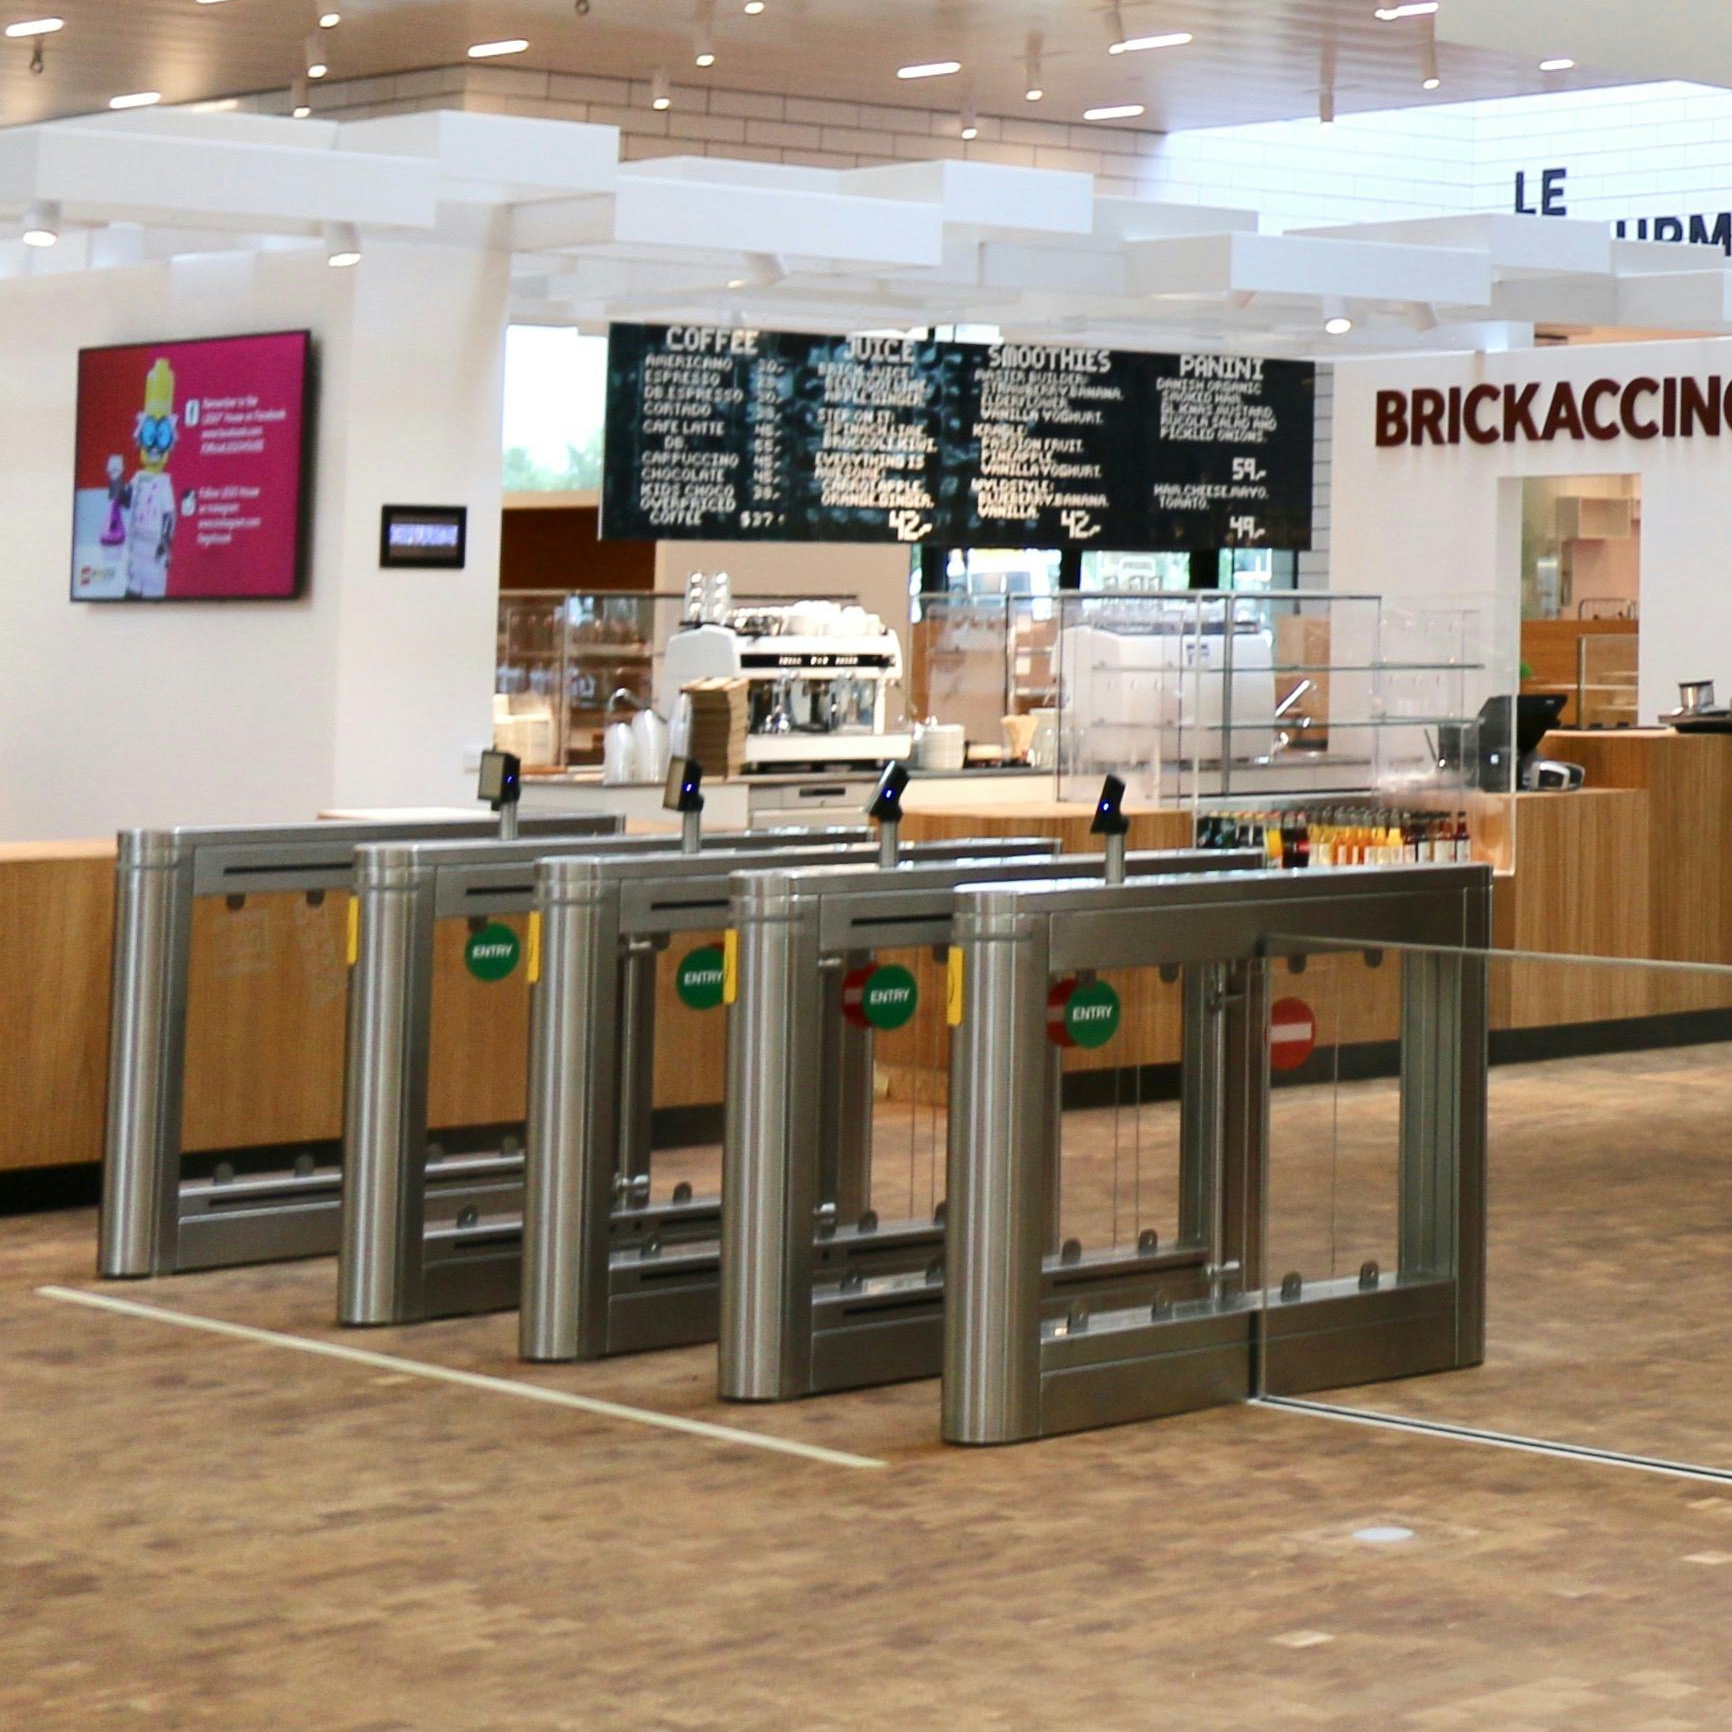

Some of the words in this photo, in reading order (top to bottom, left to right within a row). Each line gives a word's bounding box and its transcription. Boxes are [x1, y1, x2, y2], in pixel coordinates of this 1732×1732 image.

[1515, 167, 1566, 217] LE
[666, 326, 760, 355] COFFEE
[843, 337, 916, 364] JUICE
[988, 345, 1112, 373] SMOOTHIES
[645, 354, 733, 372] AMERICANO
[1180, 354, 1264, 381] PANINI
[645, 369, 720, 387] ESPRESSO
[643, 401, 711, 418] CORTADO
[682, 421, 726, 437] LATTE
[641, 450, 739, 468] CAPPUCCINO
[641, 466, 726, 484] CHOCOLATE
[649, 509, 703, 527] COFFEE
[472, 943, 513, 959] ENTRY
[683, 970, 723, 986] ENTRY
[870, 988, 910, 1005] ENTRY
[1072, 1005, 1113, 1023] ENTRY
